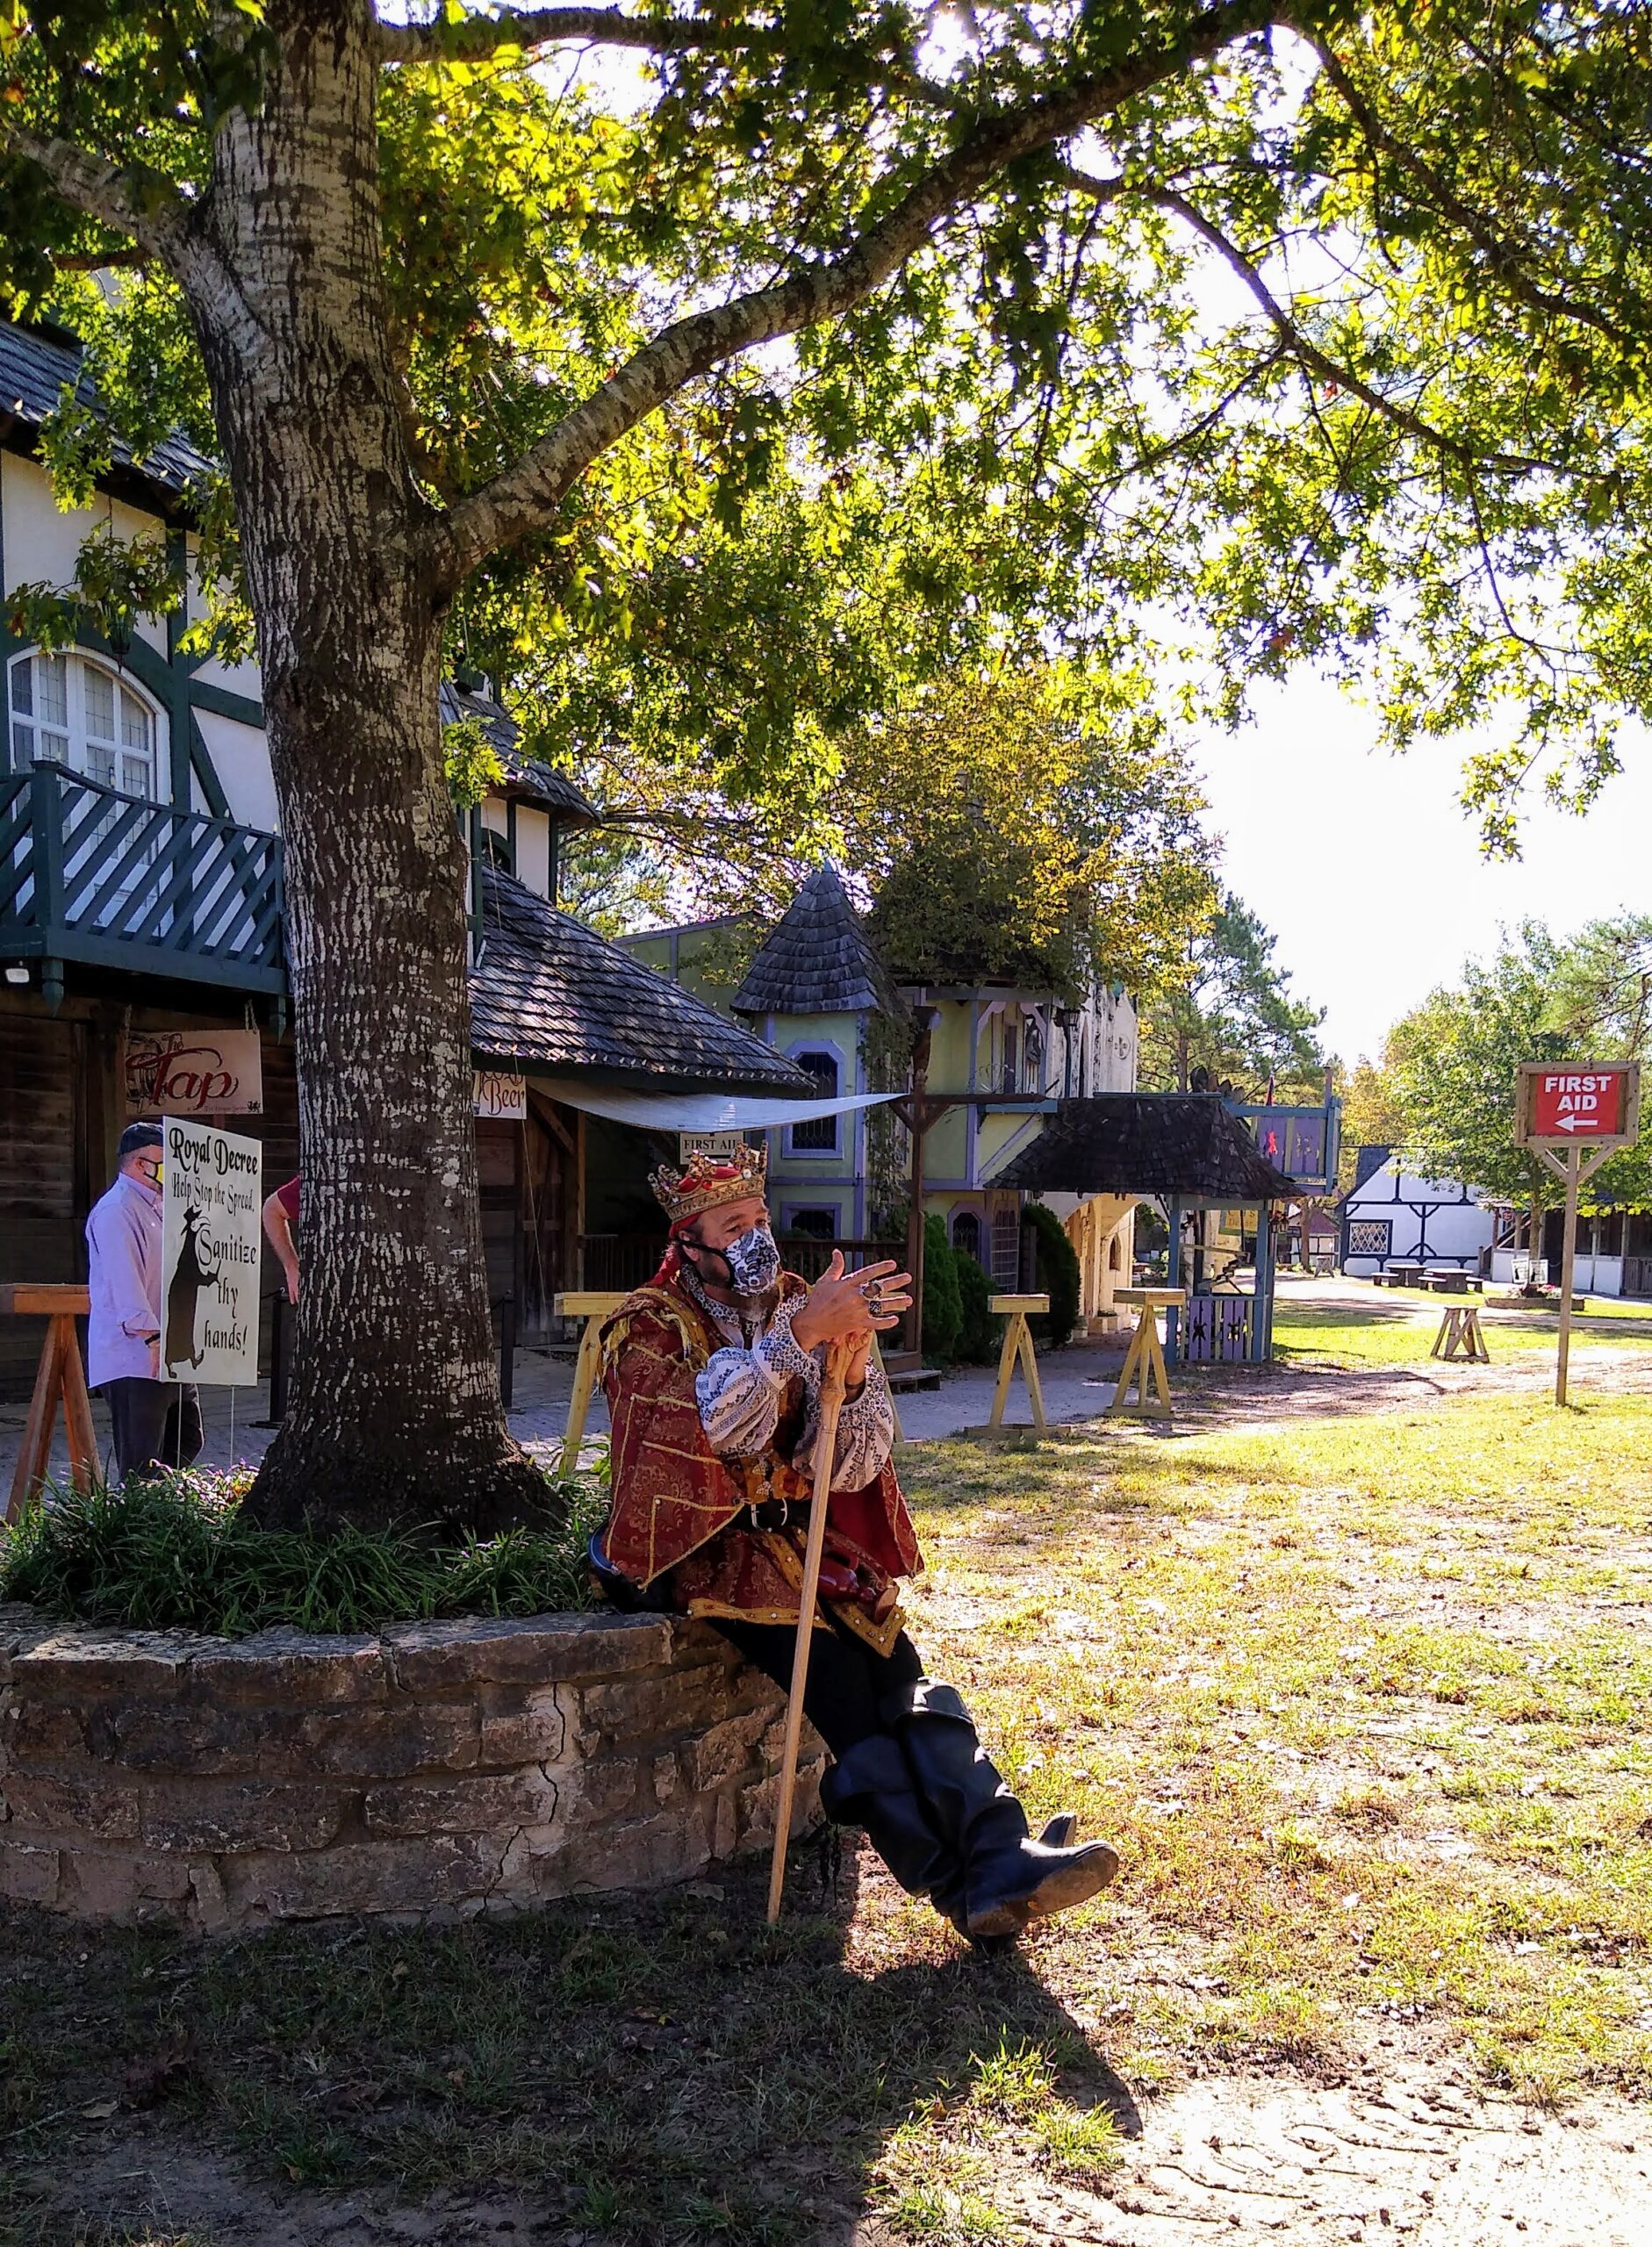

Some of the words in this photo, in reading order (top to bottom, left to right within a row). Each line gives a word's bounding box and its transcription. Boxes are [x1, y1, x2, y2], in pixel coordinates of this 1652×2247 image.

[126, 1047, 239, 1110] Tap
[1545, 1075, 1612, 1093] FIRST
[483, 1079, 525, 1116] Beer
[1556, 1095, 1598, 1111] AID
[169, 1127, 212, 1174] Royal
[214, 1138, 258, 1175] Decree
[685, 1139, 716, 1150] FIRST
[172, 1172, 191, 1208] Help
[193, 1177, 212, 1211] Stop
[214, 1181, 225, 1205] the
[198, 1229, 256, 1266] Sanitize
[218, 1277, 239, 1318] thy
[204, 1320, 248, 1356] hands!
